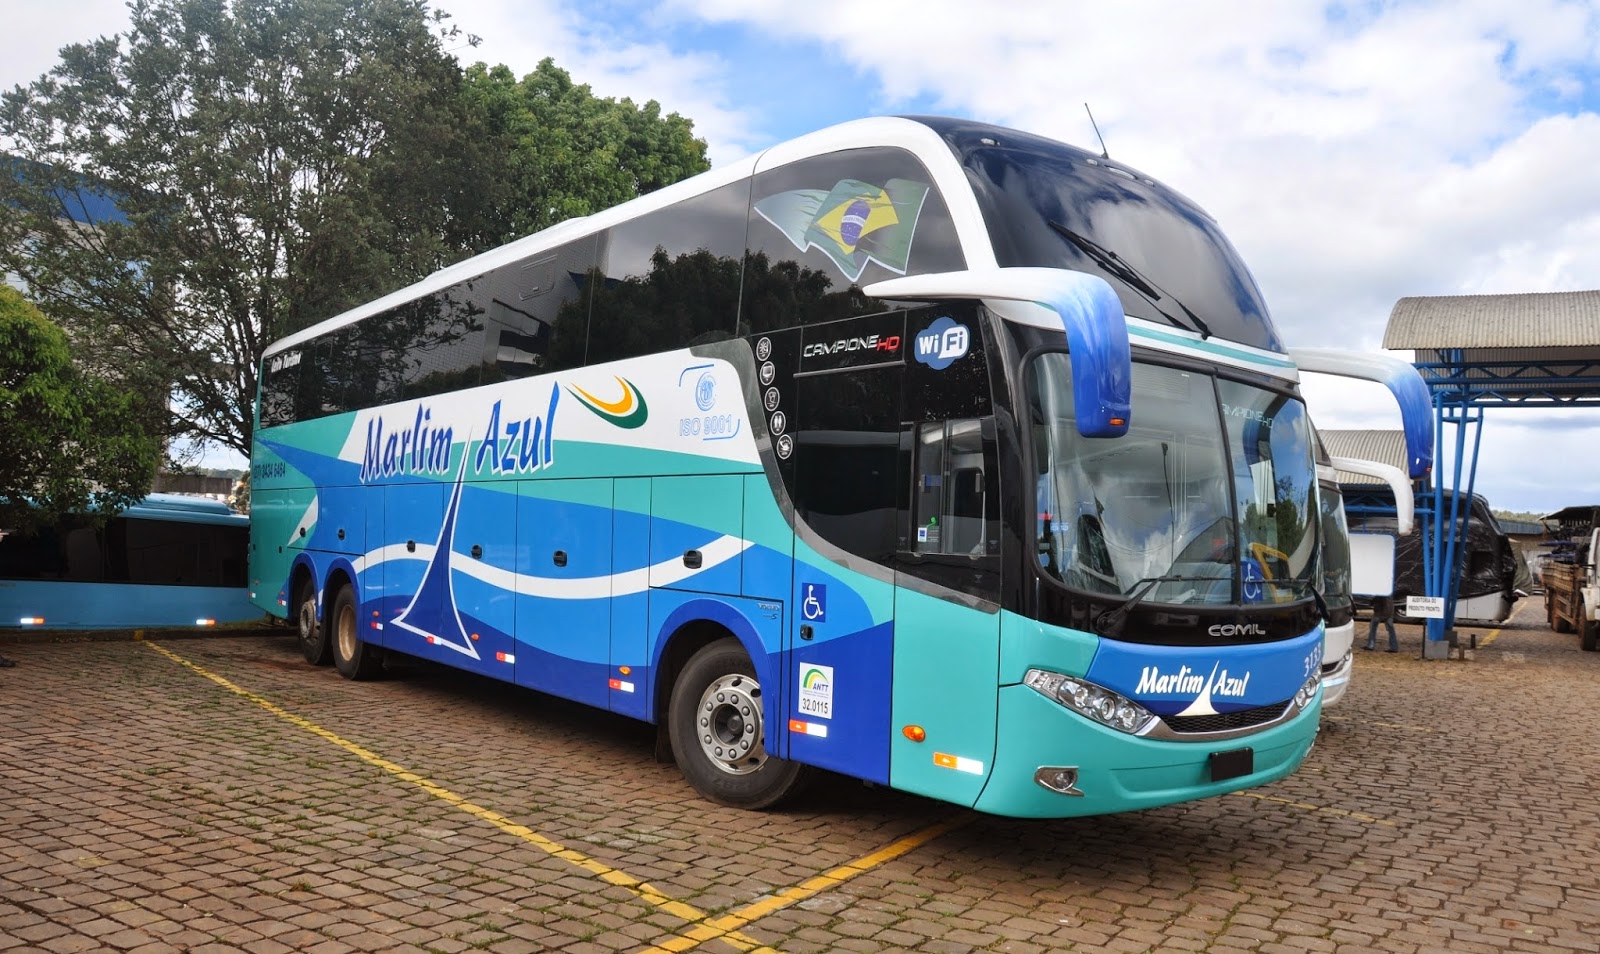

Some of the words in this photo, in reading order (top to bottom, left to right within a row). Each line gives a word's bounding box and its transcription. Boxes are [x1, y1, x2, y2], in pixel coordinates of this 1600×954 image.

[360, 402, 454, 483] Marlim
[475, 380, 560, 475] Azul
[679, 417, 701, 436] ISO
[703, 414, 732, 435] 9001
[1208, 623, 1266, 637] COMIL
[812, 682, 829, 692] ANTT
[1135, 664, 1204, 695] Marlim
[1212, 669, 1250, 697] Azul
[802, 697, 829, 714] 32.0115
